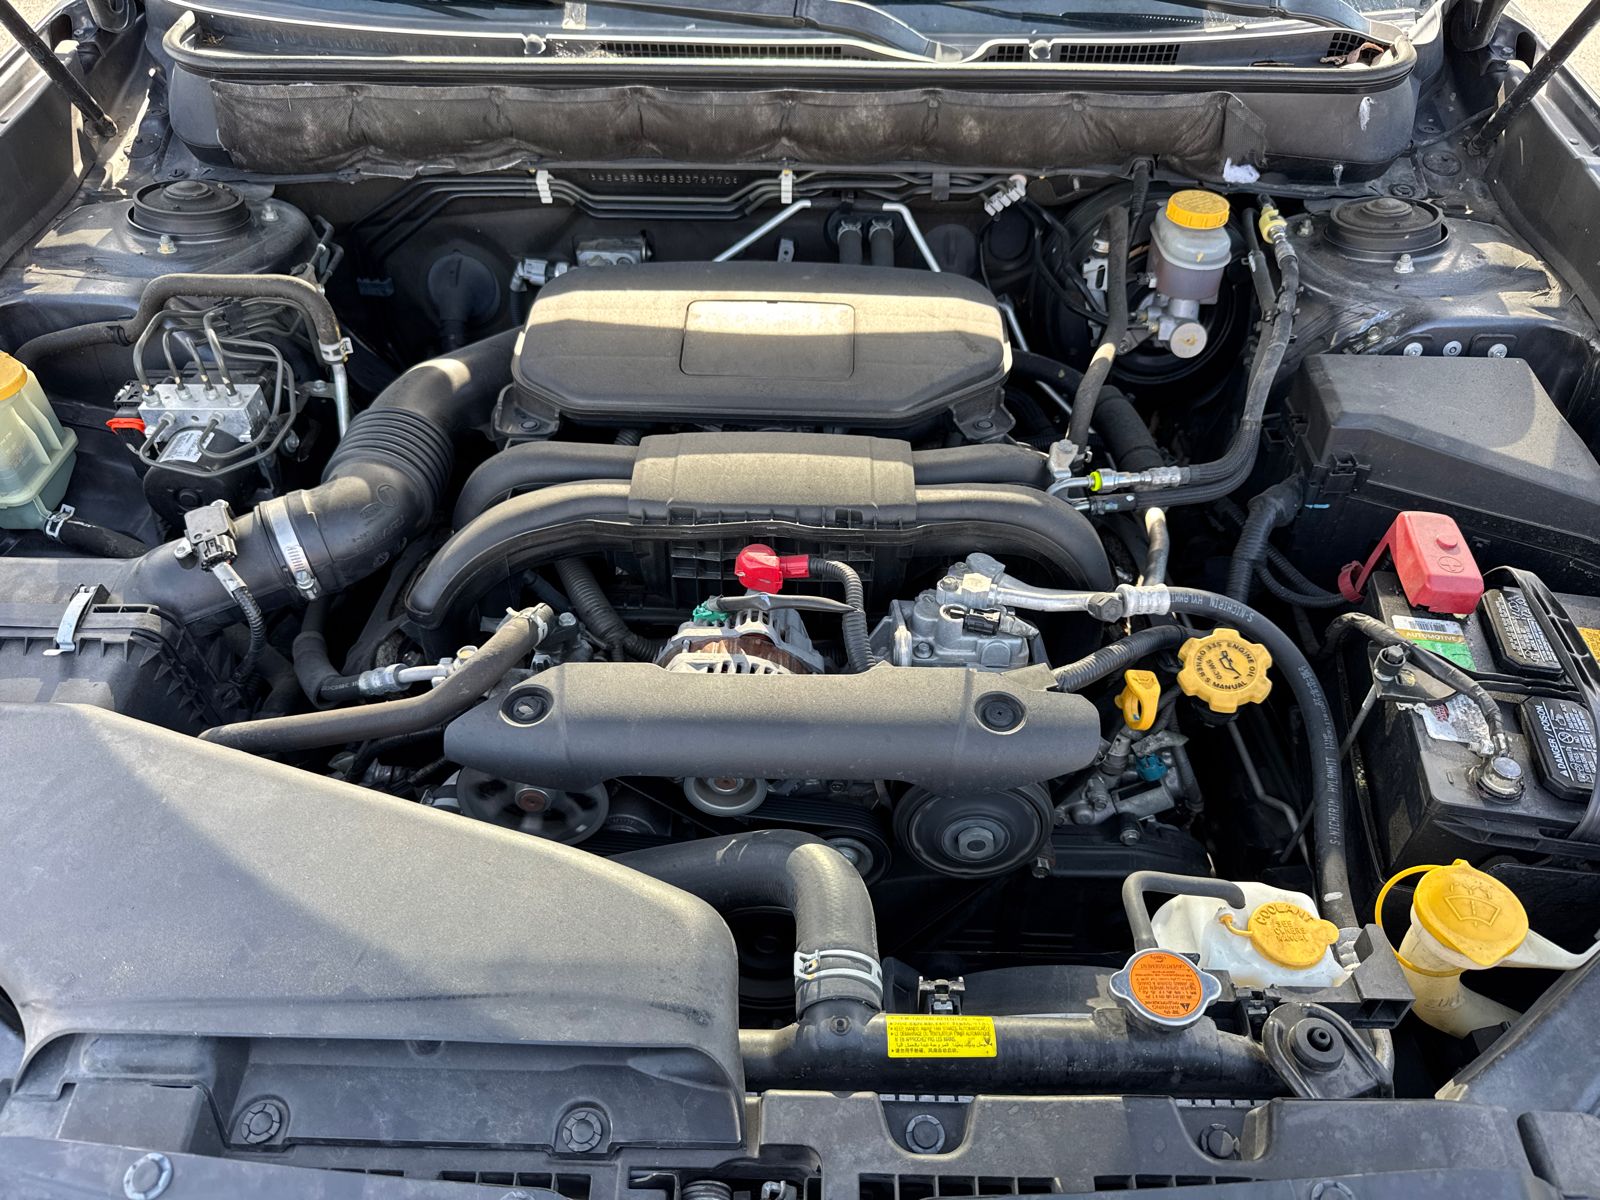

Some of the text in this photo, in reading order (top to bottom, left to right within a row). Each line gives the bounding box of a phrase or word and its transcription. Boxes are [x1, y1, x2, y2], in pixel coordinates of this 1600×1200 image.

[1406, 632, 1458, 642] AUTOMOTIVE
[1196, 641, 1247, 690] SEE OWNERS MANUAL
[1206, 659, 1223, 680] 5W-30
[1226, 641, 1256, 678] ENGINE OIL
[1534, 704, 1552, 732] POISON
[1547, 738, 1566, 769] DANGER
[1328, 798, 1341, 846] S-NICHIRIN
[1255, 904, 1314, 926] COOLANT
[1275, 920, 1292, 928] SEE
